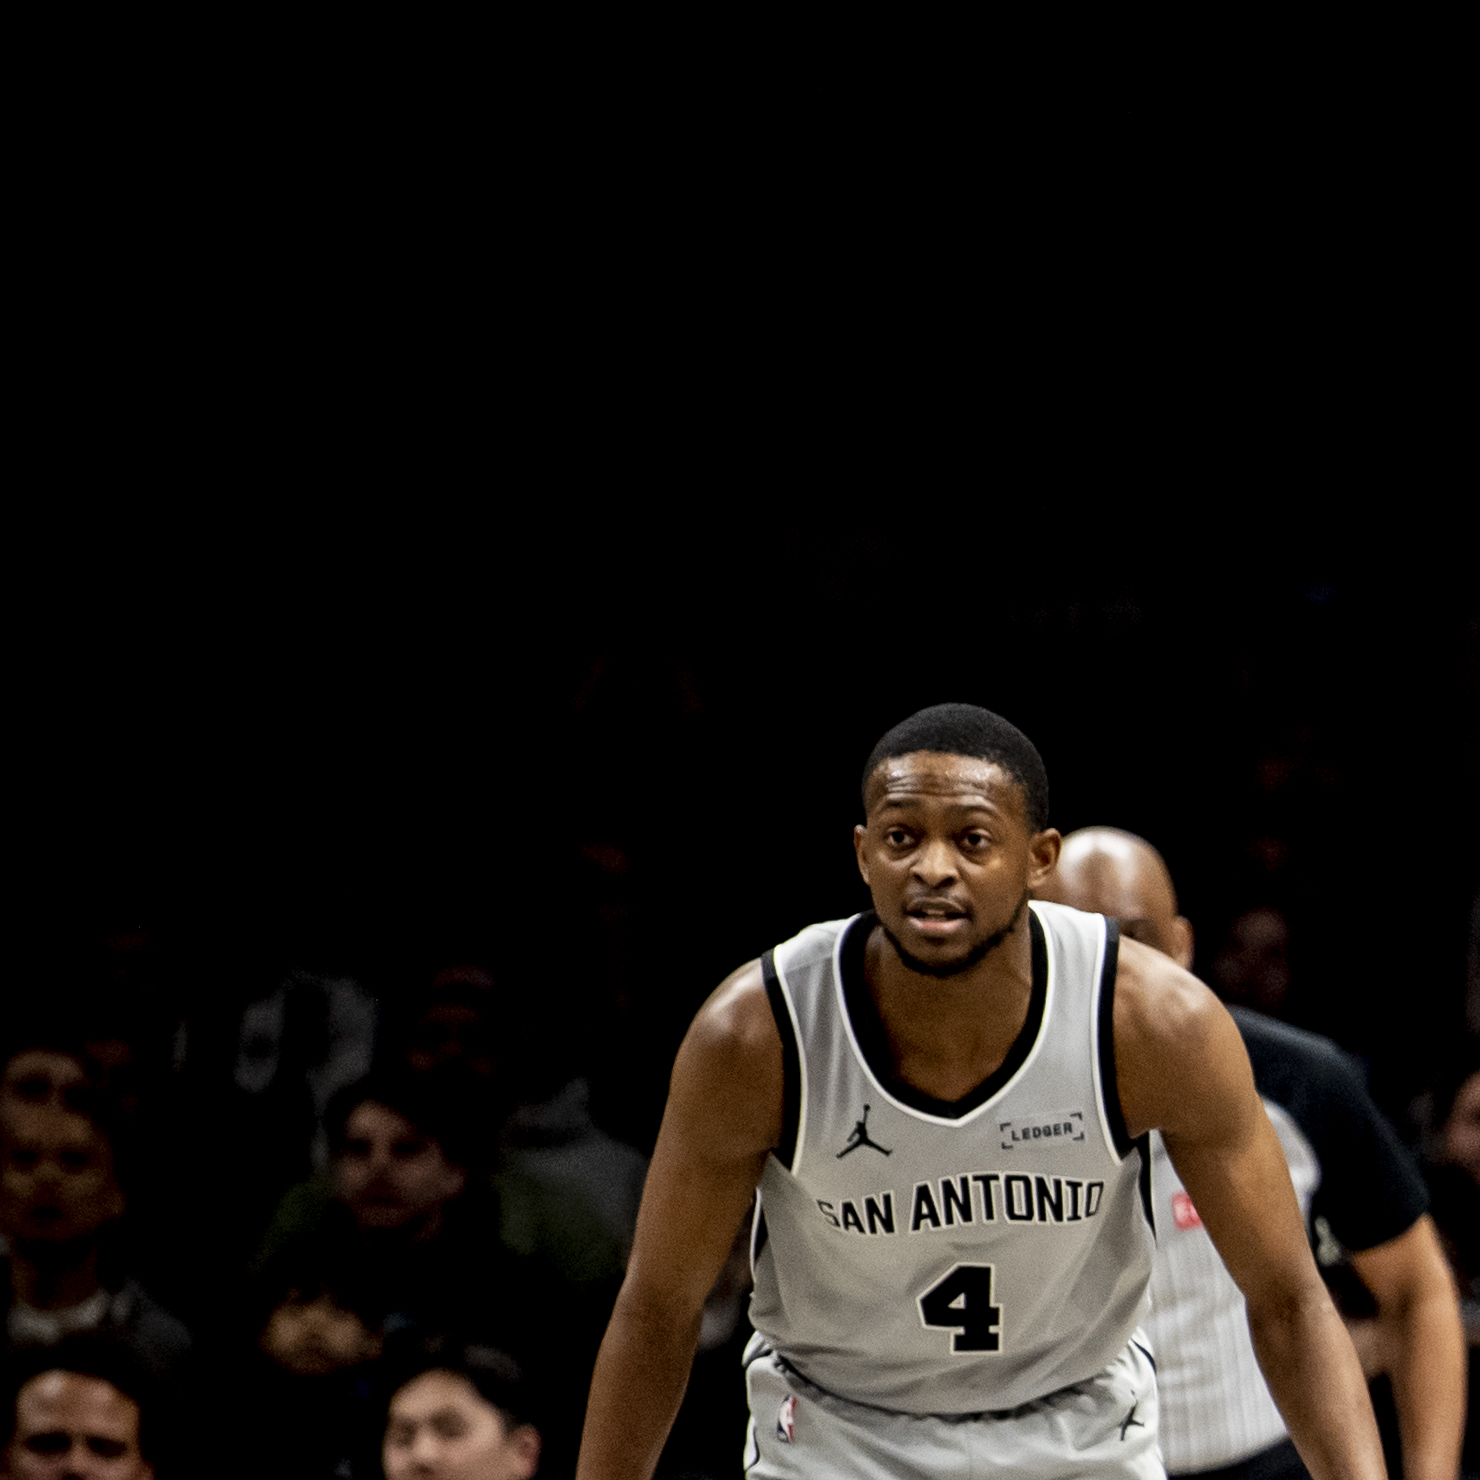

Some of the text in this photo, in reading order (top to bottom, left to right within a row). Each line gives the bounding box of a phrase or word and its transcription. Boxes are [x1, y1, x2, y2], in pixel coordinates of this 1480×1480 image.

[1011, 1121, 1073, 1142] LEDGER
[817, 1173, 1105, 1234] SAN ANTONIO
[917, 1262, 1002, 1354] 4
